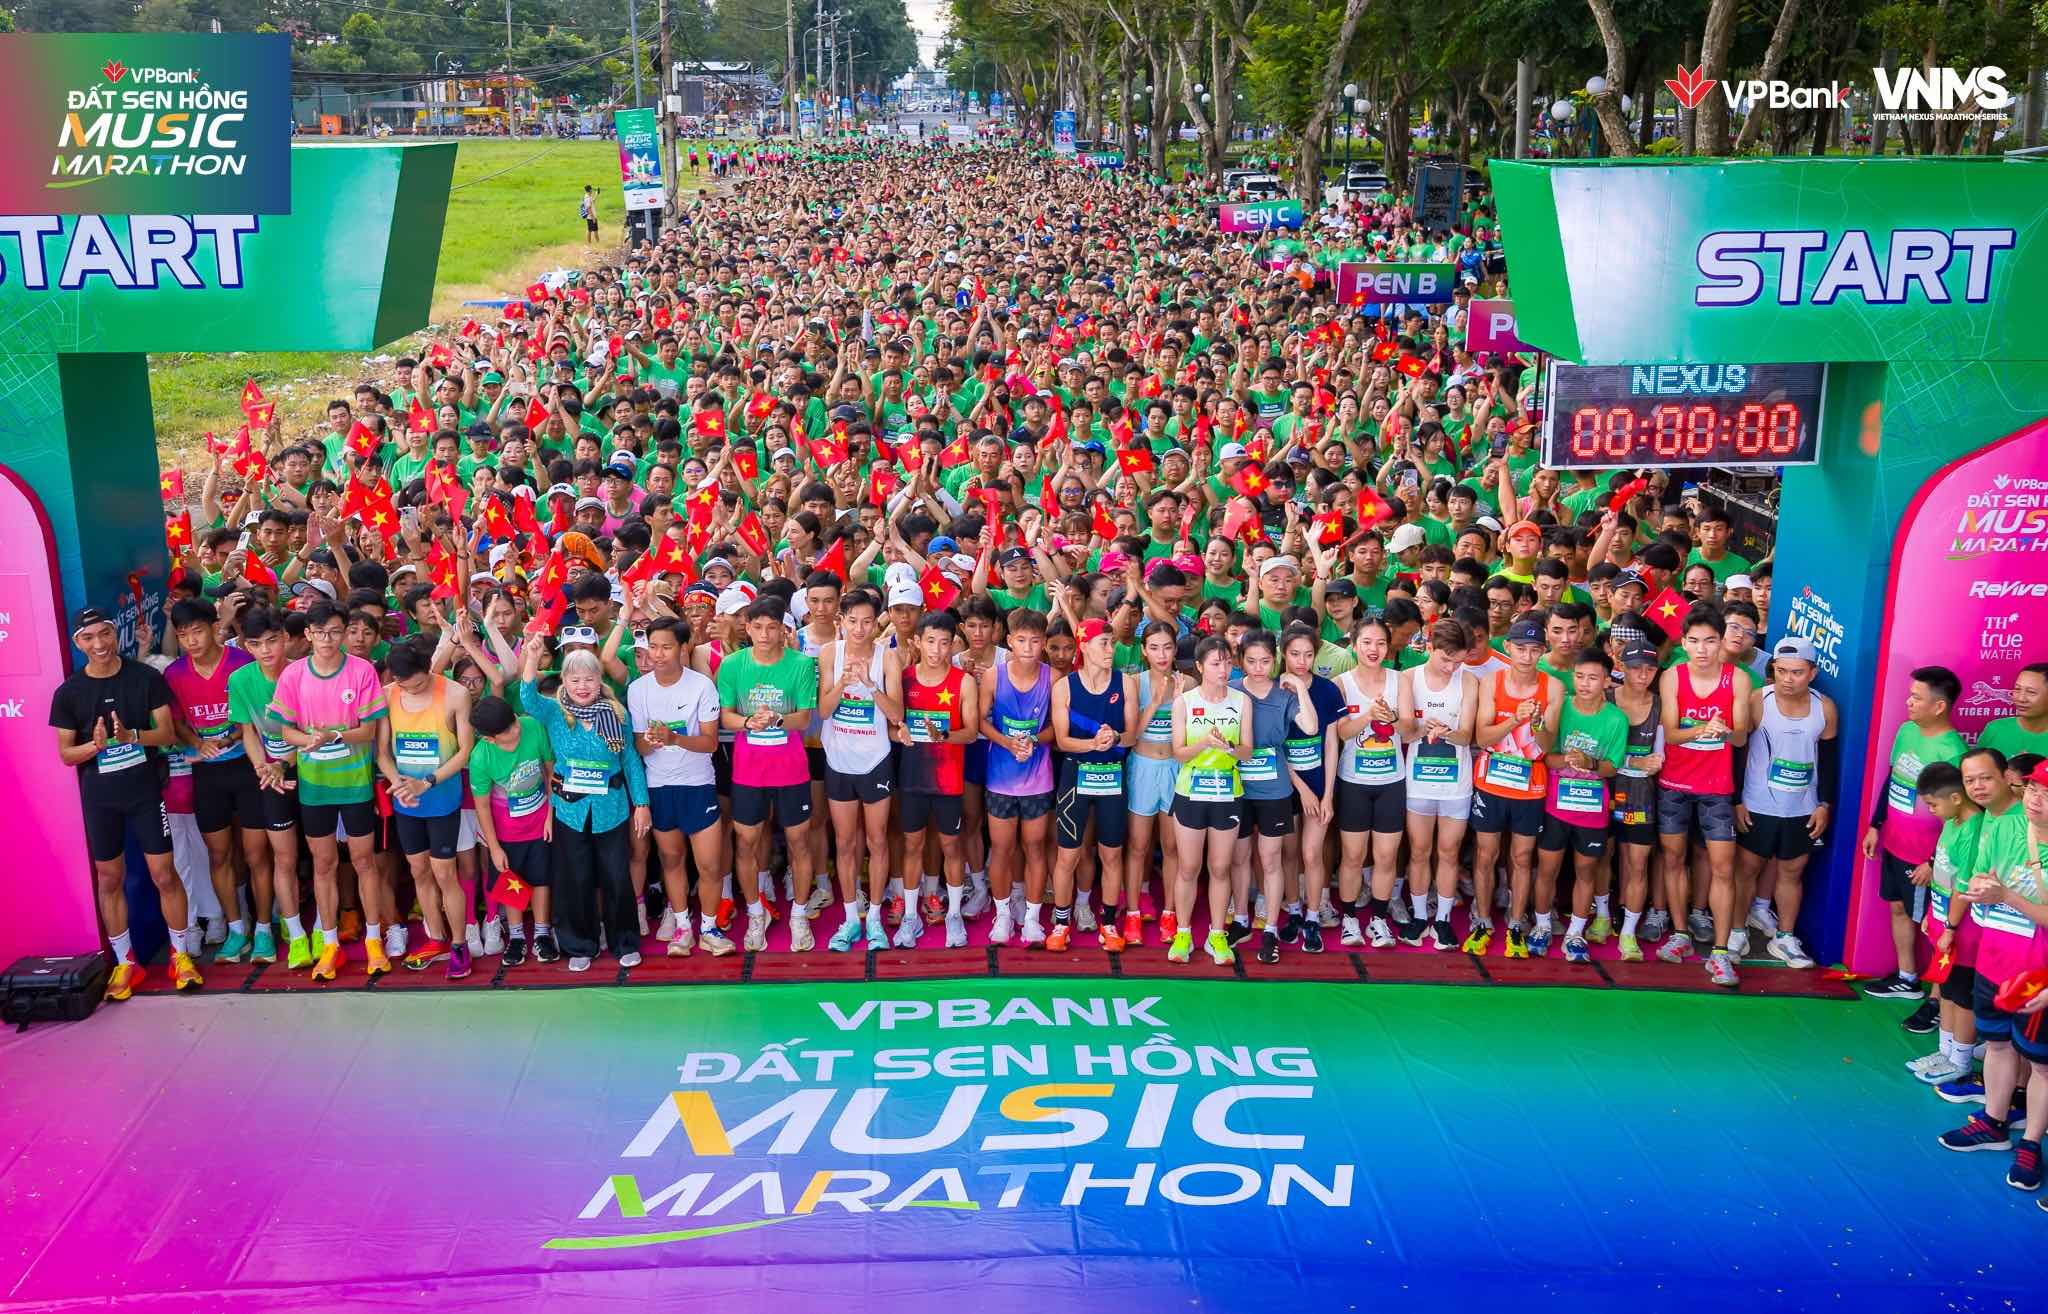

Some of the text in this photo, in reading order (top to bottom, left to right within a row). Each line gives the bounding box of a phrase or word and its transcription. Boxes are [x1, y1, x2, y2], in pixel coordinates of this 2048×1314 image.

[1109, 155, 1117, 165] D
[1233, 207, 1290, 225] PEN C
[0, 214, 259, 289] TART
[1696, 229, 2016, 306] START
[1356, 272, 1437, 294] PEN B
[1632, 365, 1747, 394] NEXUS
[1572, 403, 1799, 457] 00:00:00
[1967, 489, 2001, 508] ĐẤT
[2004, 495, 2040, 508] SEN
[1969, 580, 2048, 598] Revive
[1984, 616, 2010, 630] TH
[1787, 610, 1841, 660] MUSIC
[1980, 630, 2023, 648] true
[1980, 649, 2022, 660] WATER
[1958, 706, 1990, 716] TIGER
[1191, 717, 1239, 726] ANTA
[571, 768, 602, 779] 52046
[1085, 773, 1115, 782] 52003
[818, 997, 1168, 1031] VPBANK
[677, 1034, 1318, 1083] ĐẤT SEN HỒNG
[621, 1084, 1314, 1156] MUSIC
[577, 1163, 1355, 1219] MARATHON
